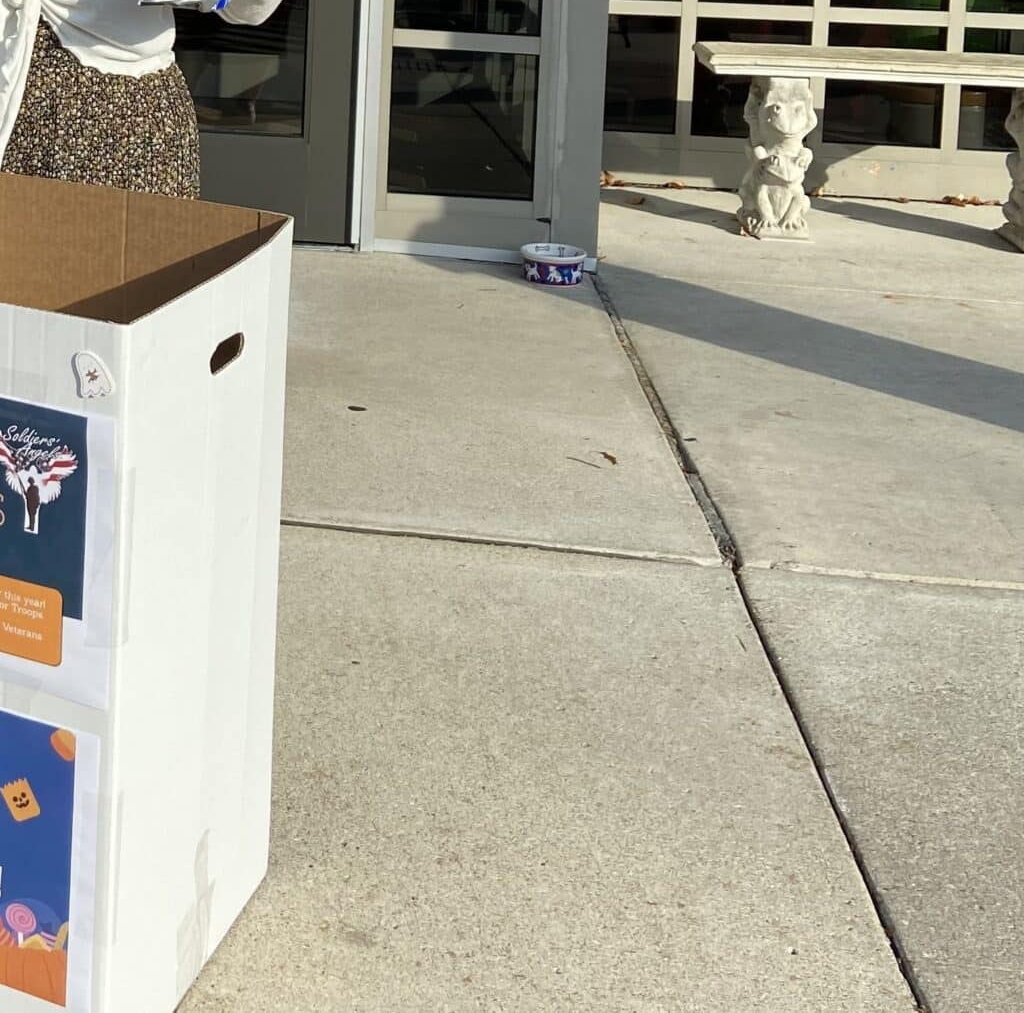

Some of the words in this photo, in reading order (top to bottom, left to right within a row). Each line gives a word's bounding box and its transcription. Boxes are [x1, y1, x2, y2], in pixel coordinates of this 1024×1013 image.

[4, 591, 20, 602] this
[24, 597, 46, 609] year!
[11, 602, 44, 619] Troops
[2, 621, 43, 641] Veterans
